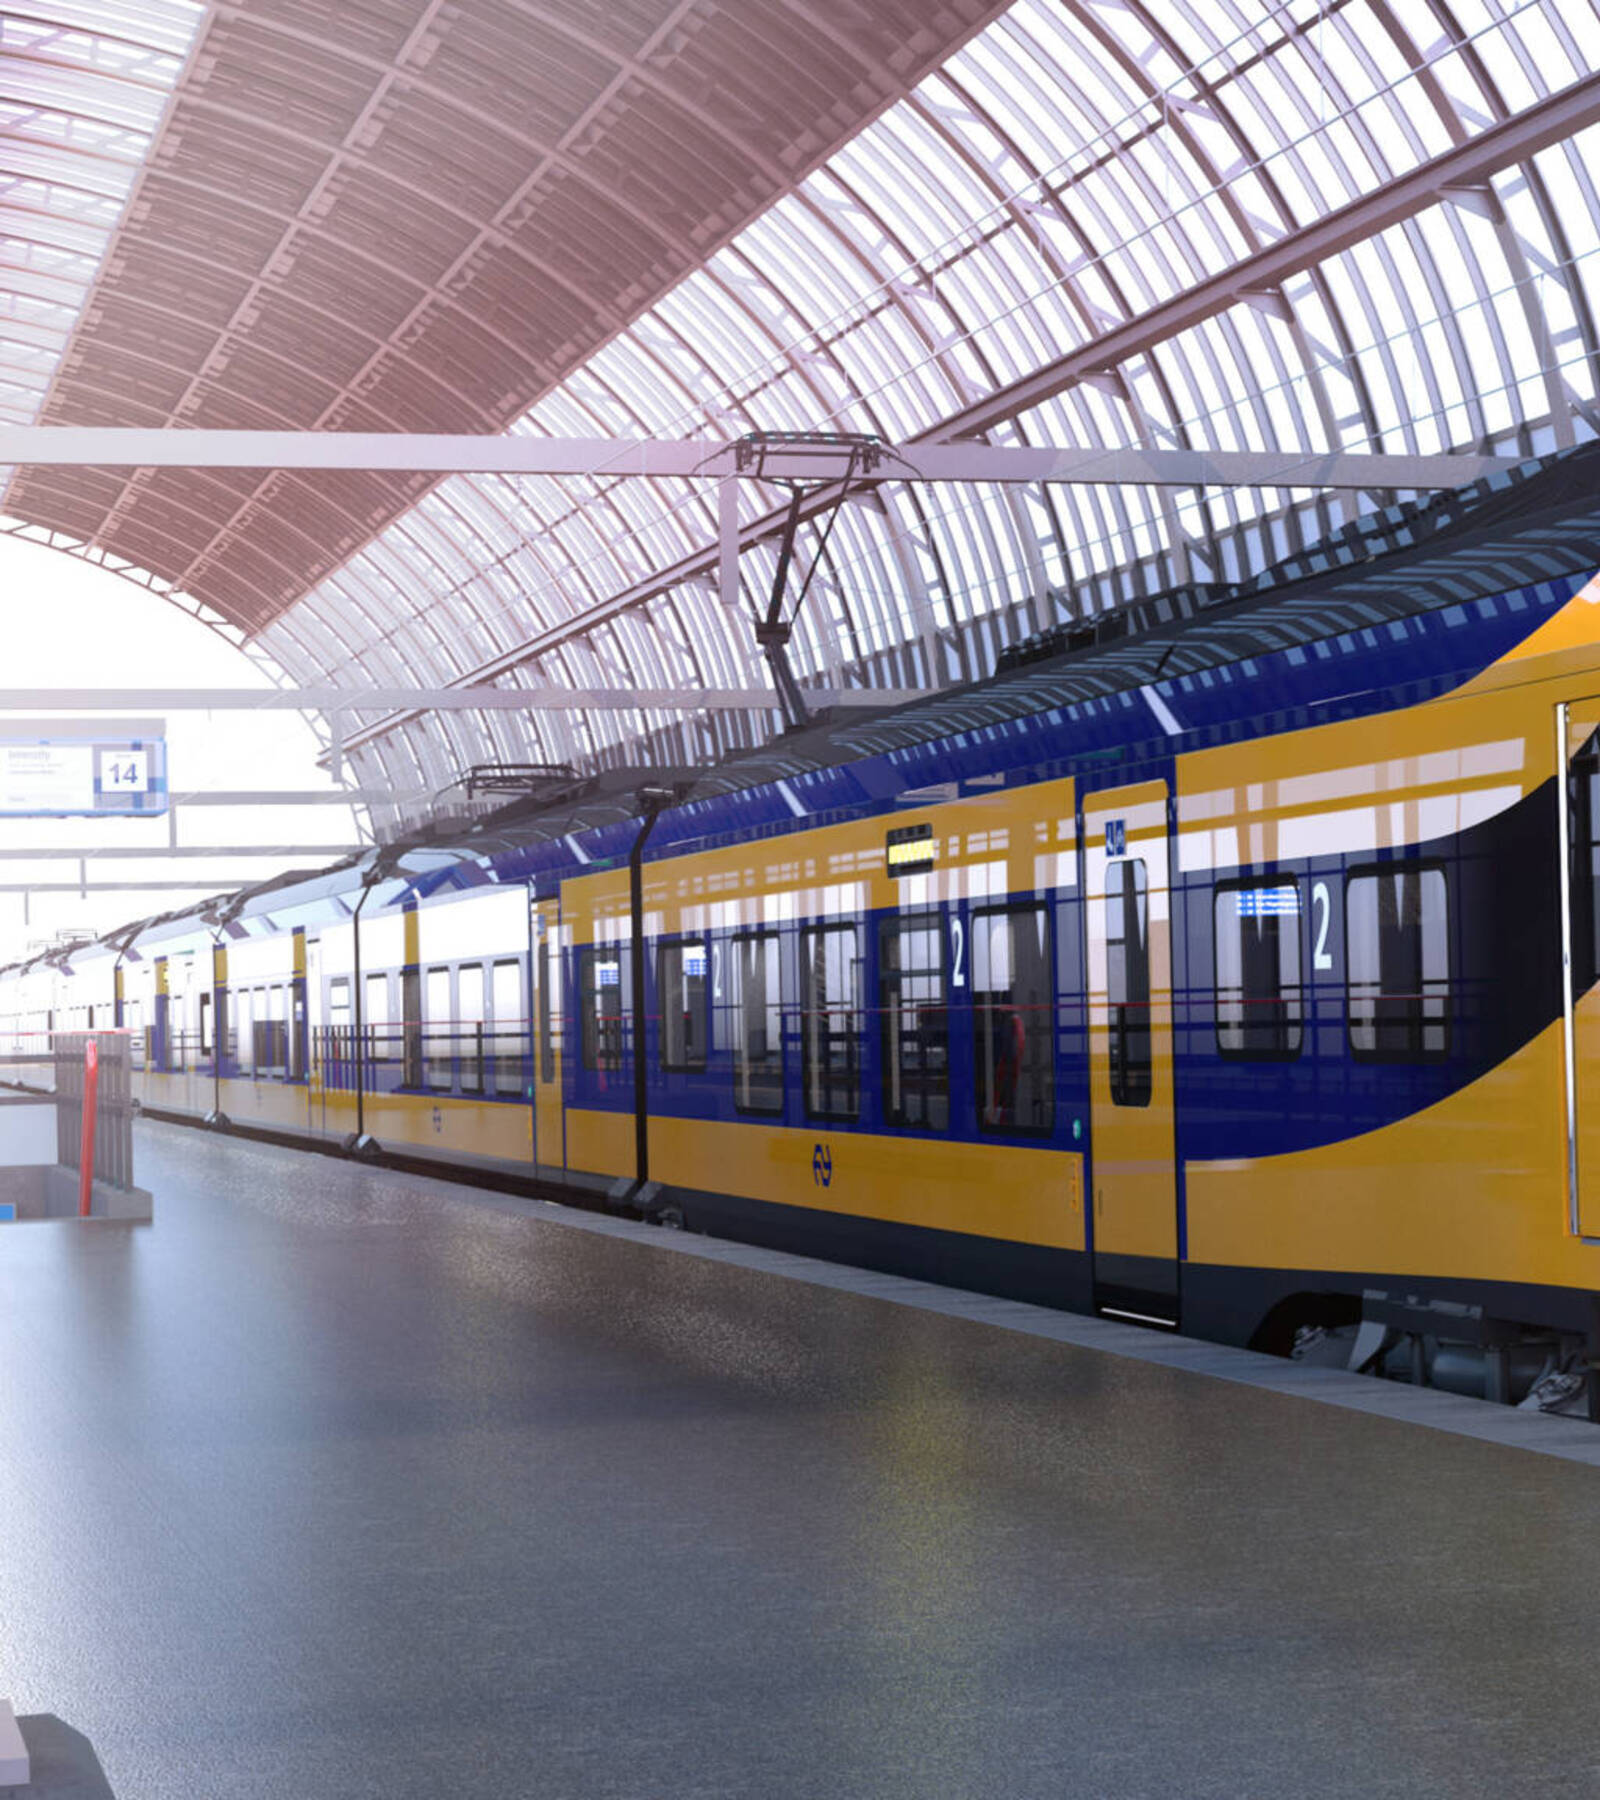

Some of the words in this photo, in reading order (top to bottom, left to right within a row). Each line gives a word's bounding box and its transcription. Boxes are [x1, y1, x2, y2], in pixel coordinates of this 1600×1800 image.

[109, 763, 138, 784] 14
[952, 918, 965, 987] 2
[1312, 881, 1332, 970] 2
